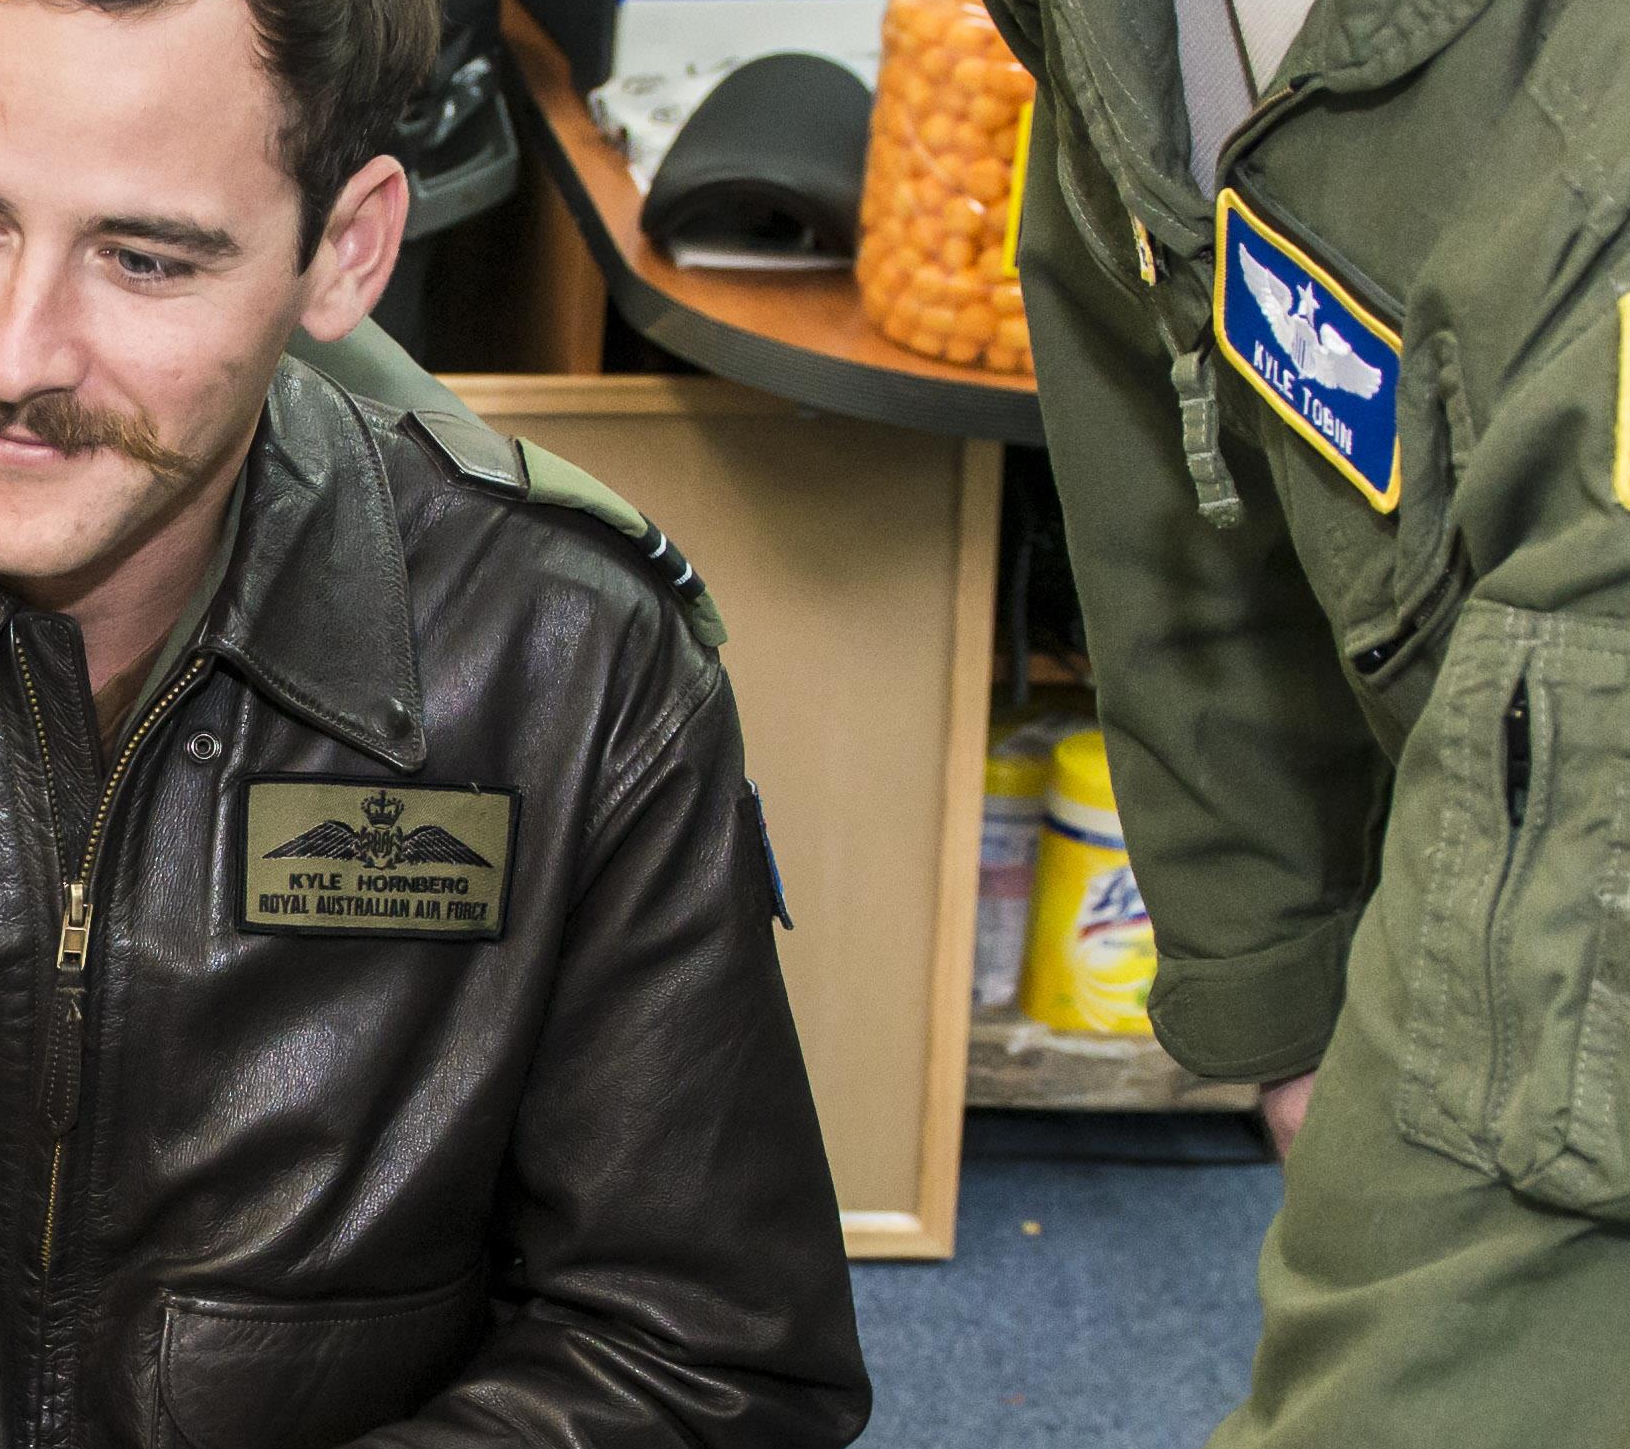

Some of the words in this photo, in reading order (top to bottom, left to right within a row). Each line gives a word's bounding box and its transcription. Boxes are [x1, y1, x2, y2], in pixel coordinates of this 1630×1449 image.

[1253, 339, 1296, 401] KYLE
[1302, 387, 1353, 456] TOBIN
[289, 873, 342, 891] KYLE
[358, 874, 469, 895] HORNBERG
[259, 894, 309, 914] ROYAL
[316, 895, 409, 918] AUSTRALIAN
[415, 899, 441, 920] AIR
[447, 901, 489, 921] FORCE
